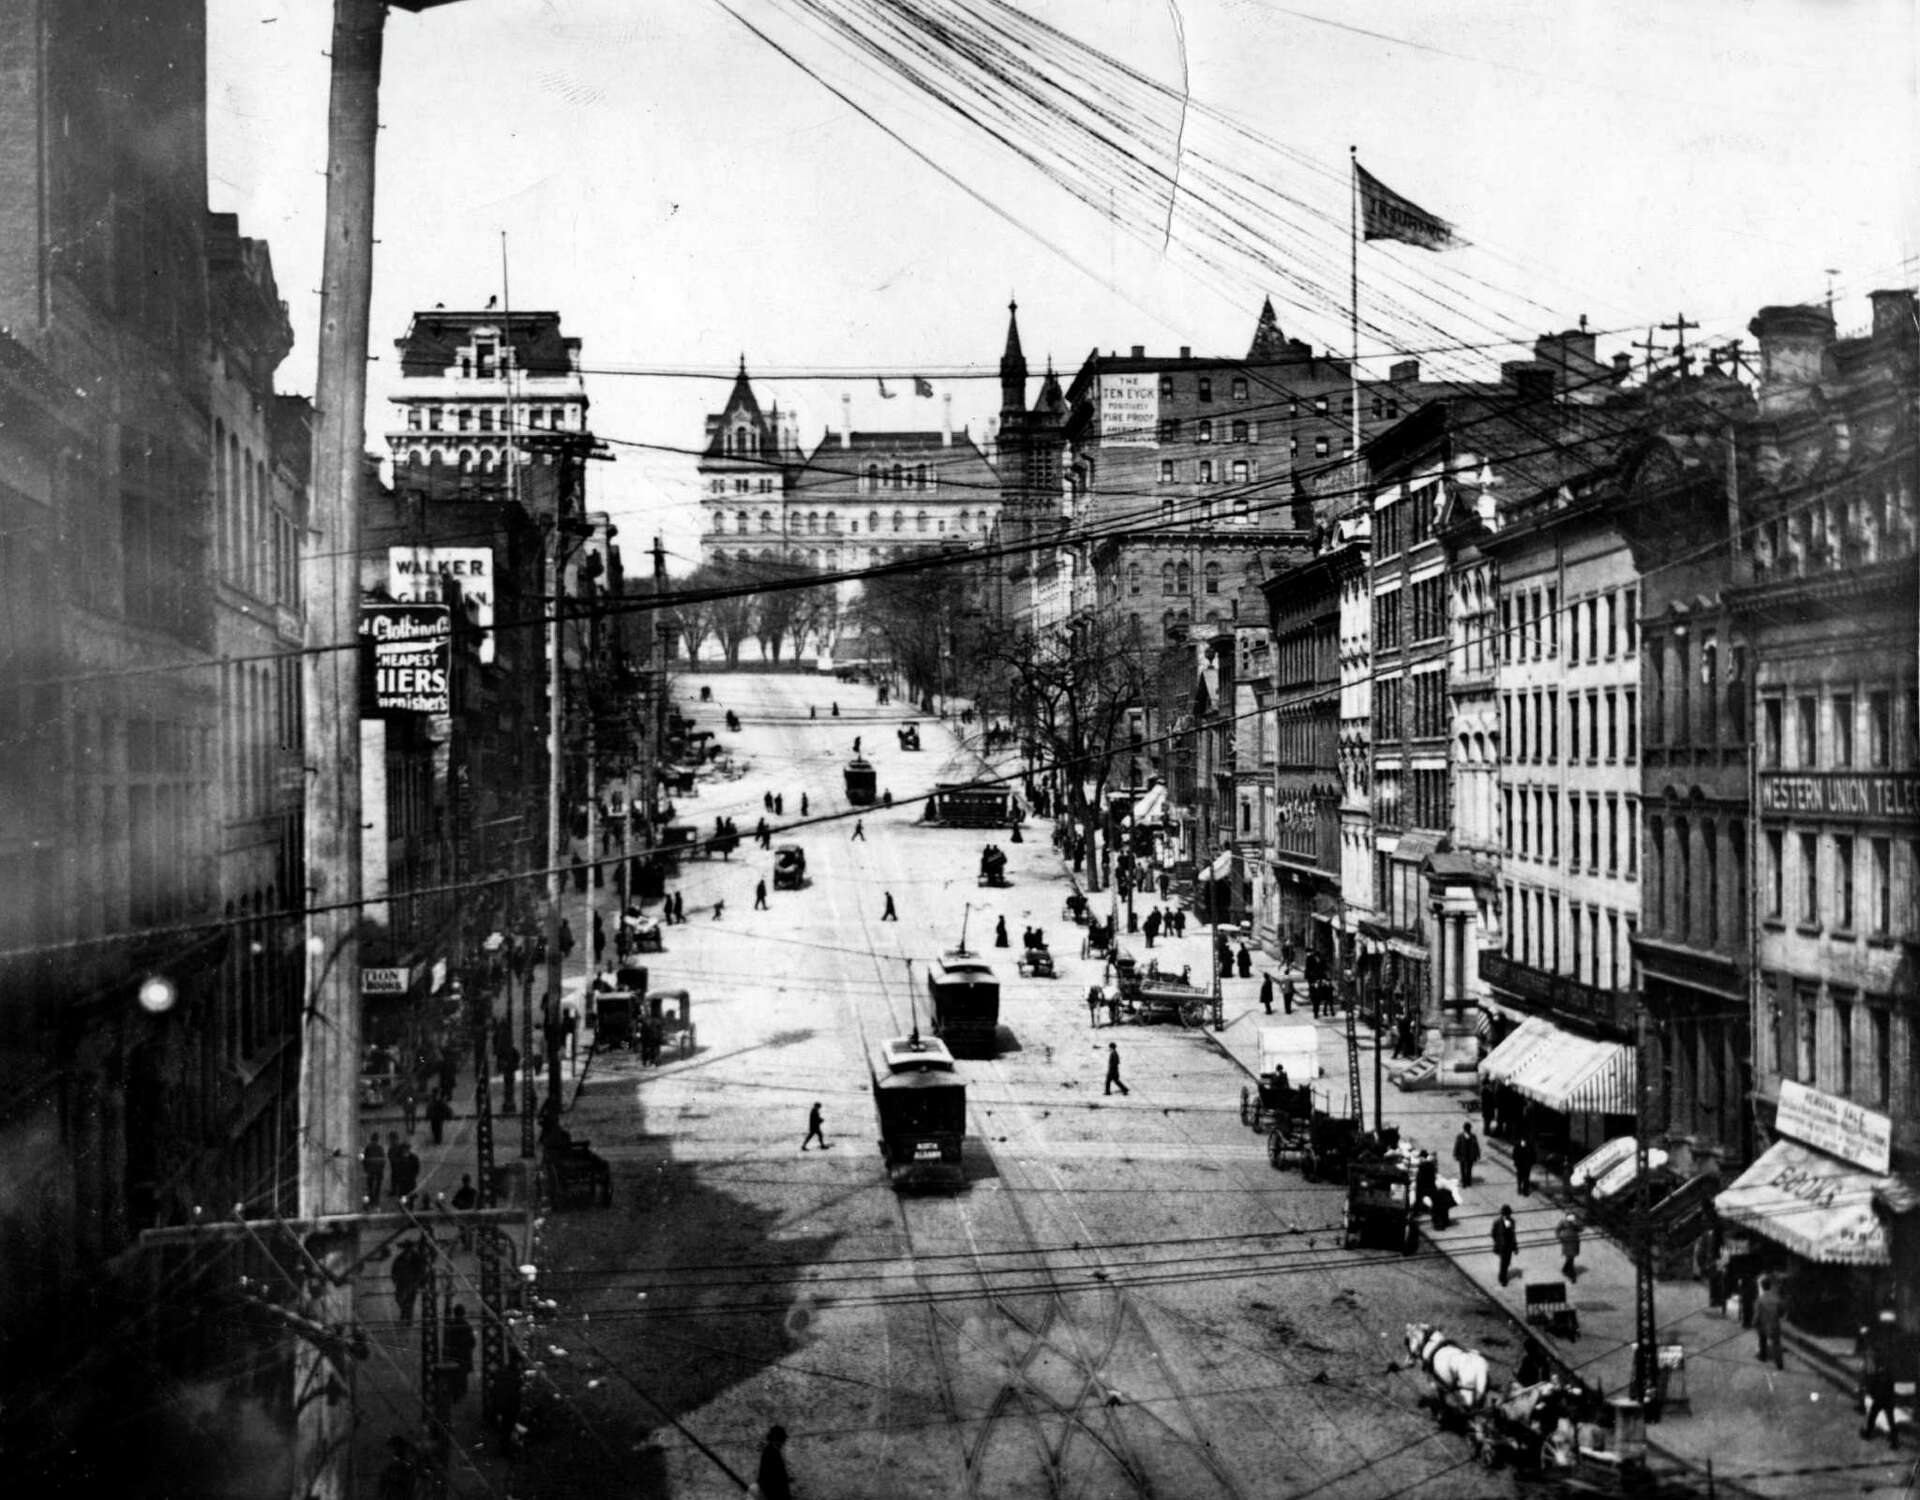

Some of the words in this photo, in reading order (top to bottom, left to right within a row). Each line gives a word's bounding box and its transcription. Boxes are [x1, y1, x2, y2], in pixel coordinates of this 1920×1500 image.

[1103, 388, 1123, 399] TEN
[396, 560, 484, 576] WALKER
[376, 653, 440, 667] HEAPEST
[1763, 777, 1823, 811] WESTERN
[1827, 778, 1869, 813] UNION
